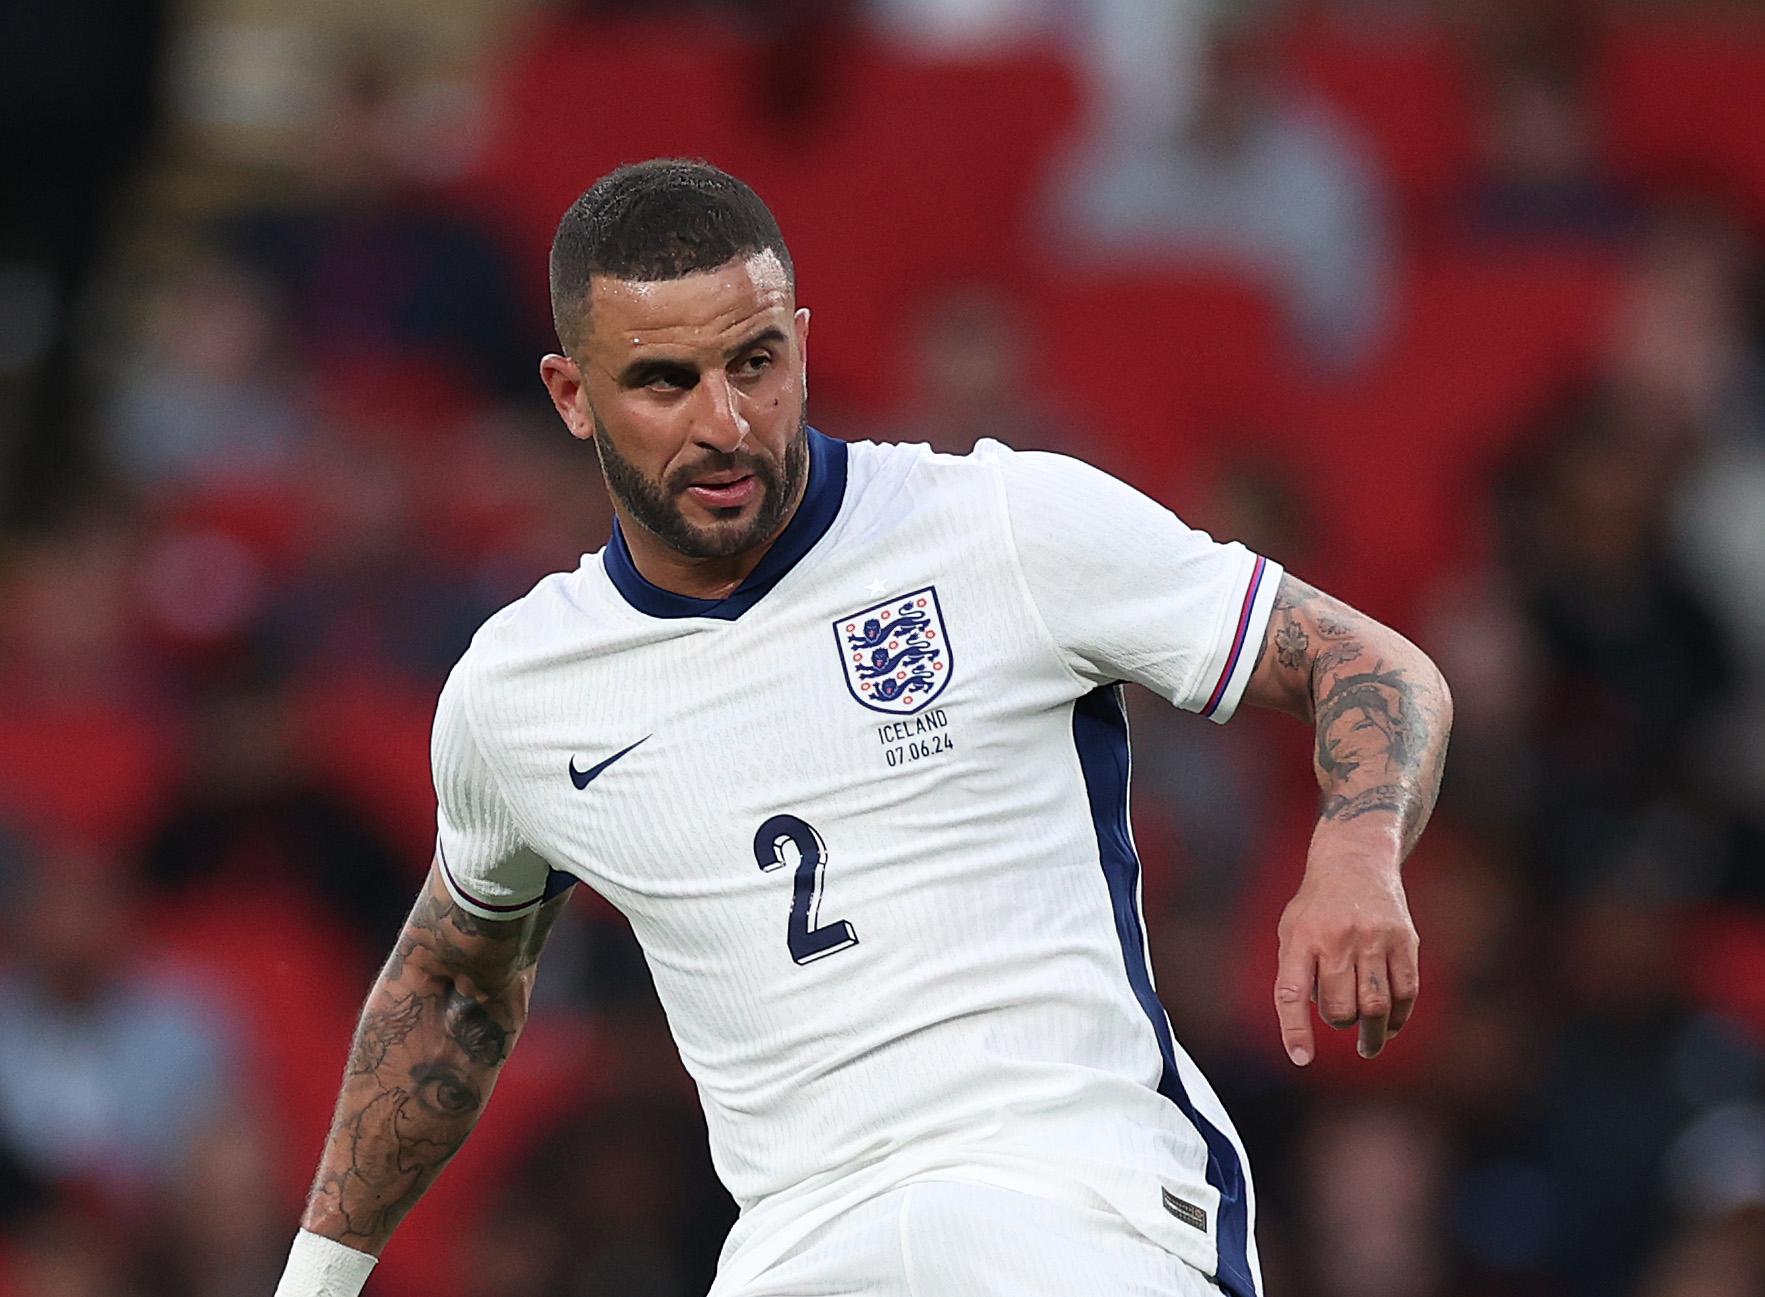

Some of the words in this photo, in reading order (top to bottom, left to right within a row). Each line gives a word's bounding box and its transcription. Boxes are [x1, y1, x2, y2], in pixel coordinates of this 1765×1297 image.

[878, 710, 948, 745] ICELAND
[886, 733, 953, 767] 07.06.24
[753, 813, 859, 966] 2
